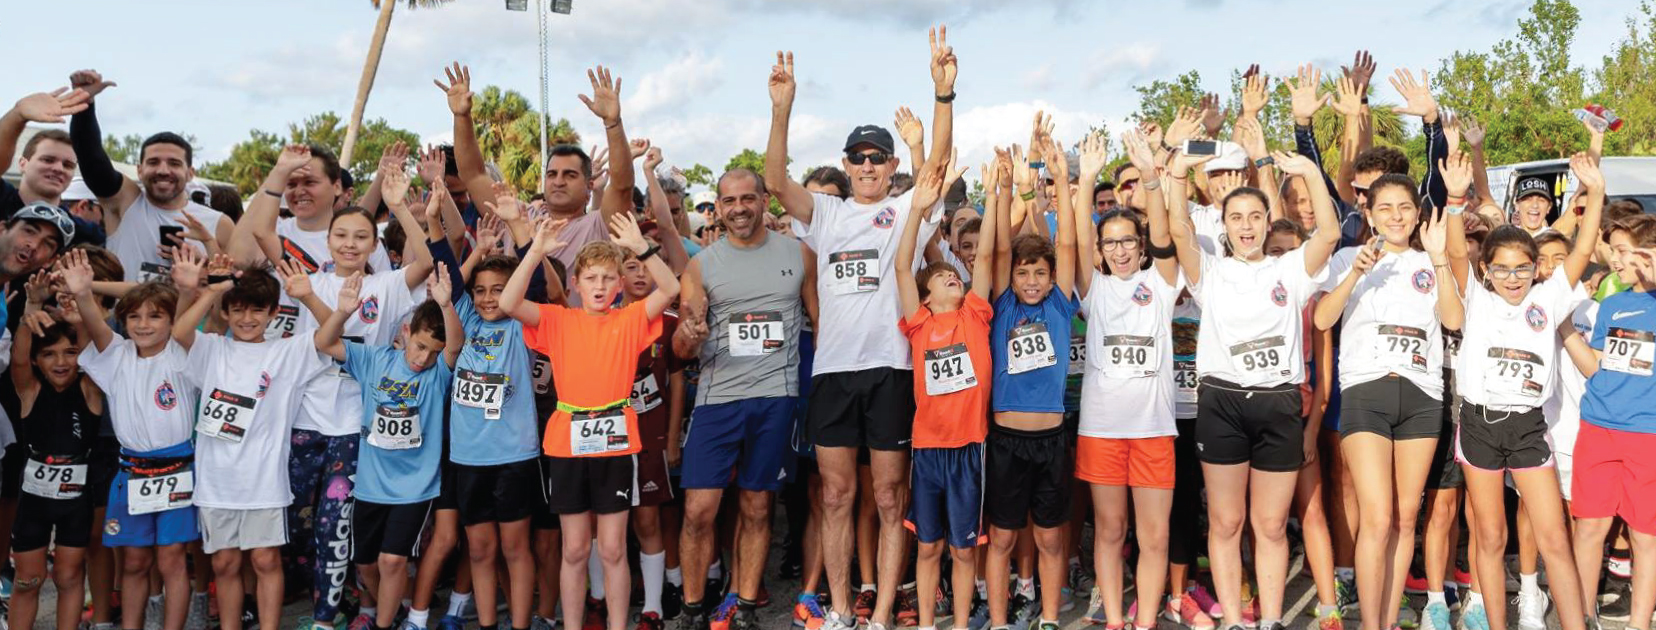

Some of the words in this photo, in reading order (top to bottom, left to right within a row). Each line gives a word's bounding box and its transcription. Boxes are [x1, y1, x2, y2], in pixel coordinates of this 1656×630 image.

[835, 262, 866, 279] 858
[738, 324, 770, 340] 501
[1012, 335, 1046, 358] 938
[1387, 336, 1421, 354] 792
[1609, 339, 1642, 357] 707
[1111, 346, 1147, 365] 940
[1243, 348, 1279, 371] 939
[931, 356, 964, 380] 947
[1497, 360, 1534, 379] 793
[456, 380, 498, 403] 1497
[203, 400, 238, 422] 668
[377, 416, 412, 436] 908
[580, 418, 616, 438] 642
[34, 465, 73, 482] 678
[140, 476, 178, 496] 679
[325, 501, 353, 607] adidas
